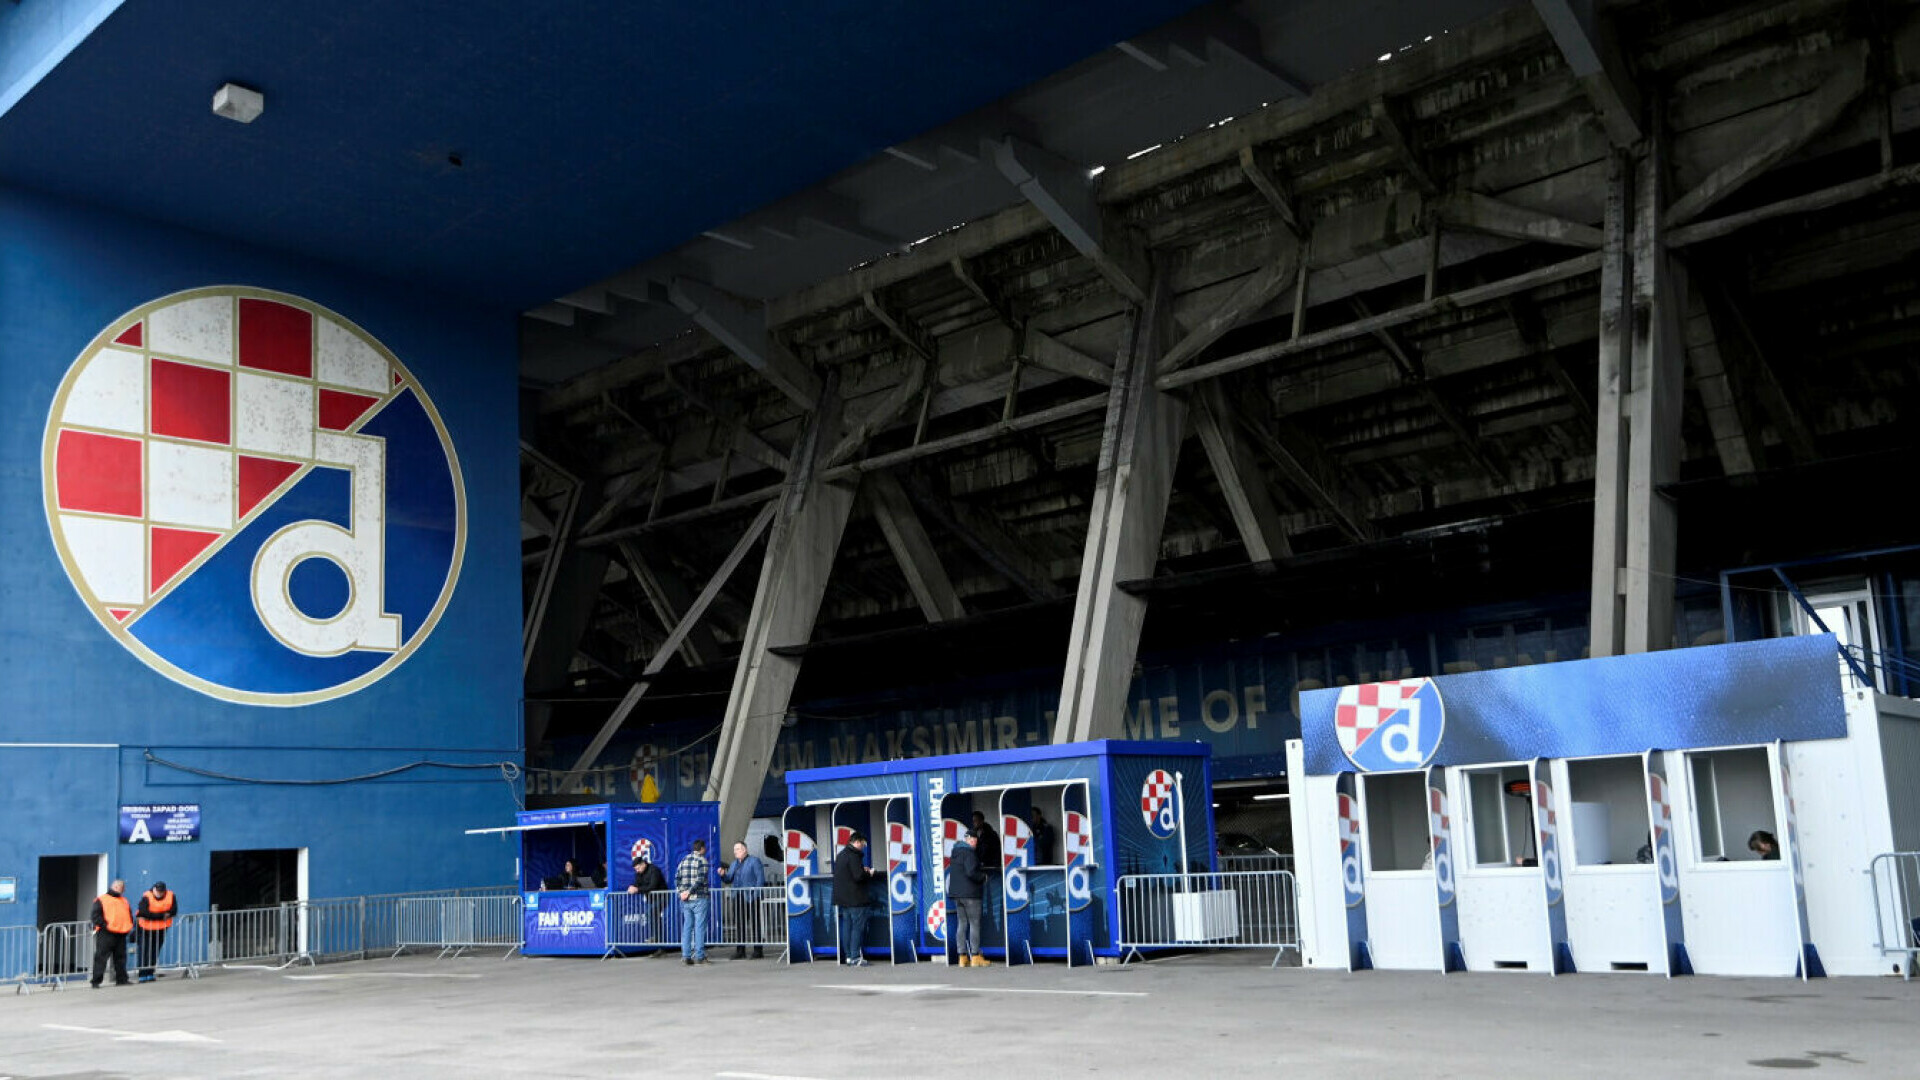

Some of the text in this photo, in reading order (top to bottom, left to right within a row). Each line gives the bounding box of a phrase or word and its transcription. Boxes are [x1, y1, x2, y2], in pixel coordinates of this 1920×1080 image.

[1201, 684, 1268, 733] OF
[152, 805, 177, 813] ZAPAD
[128, 819, 153, 843] A
[538, 911, 595, 926] FAN SHOP
